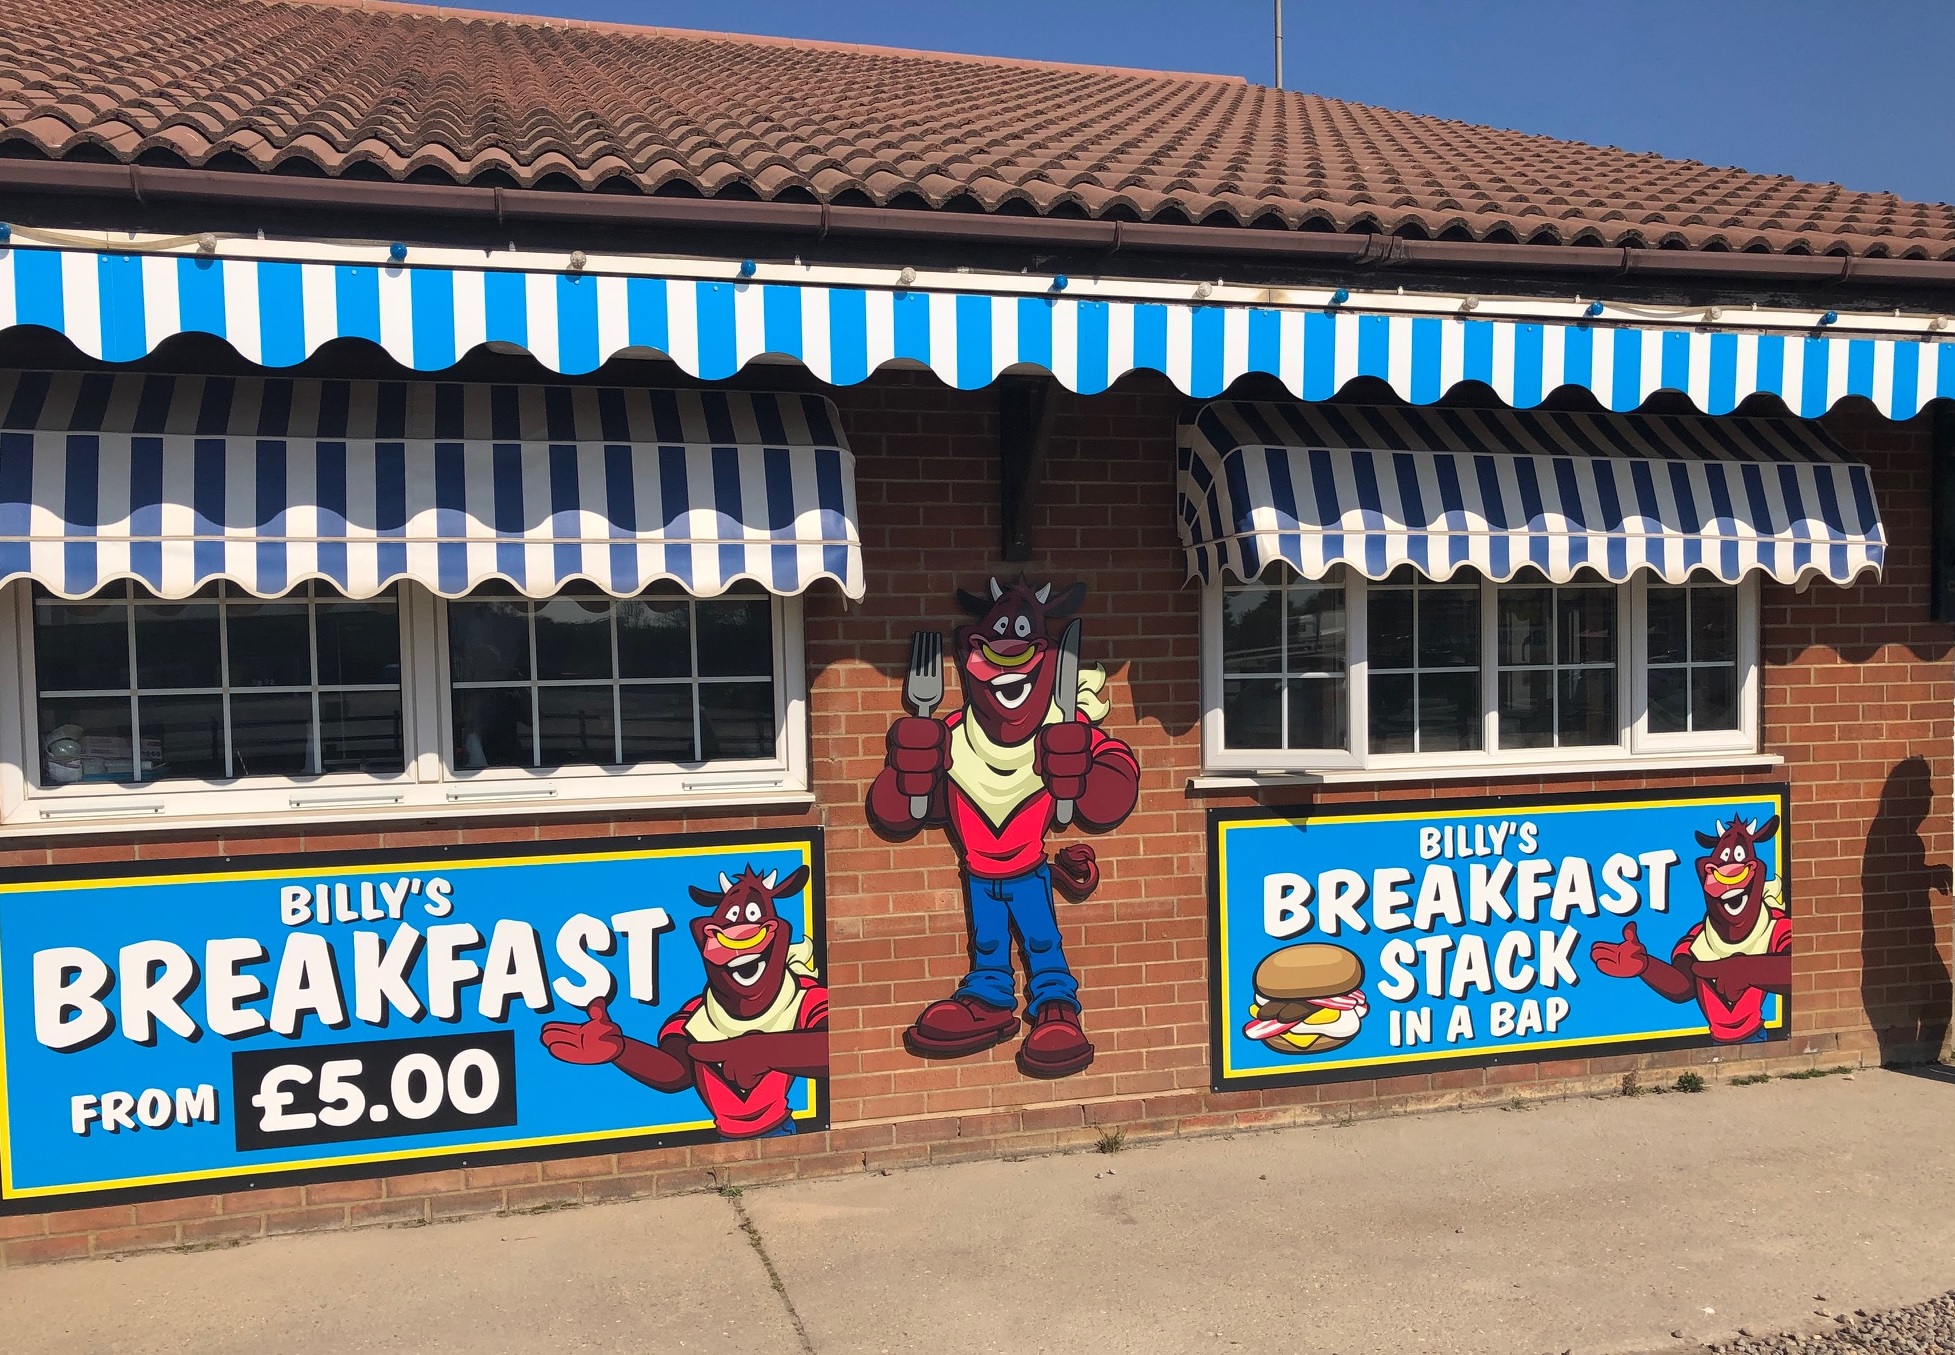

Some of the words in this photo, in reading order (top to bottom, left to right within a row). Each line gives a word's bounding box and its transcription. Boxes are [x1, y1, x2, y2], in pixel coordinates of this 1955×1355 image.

[1420, 821, 1538, 860] BILLY'S
[281, 878, 453, 926] BILLY'S
[1264, 850, 1677, 938] BREAKFAST
[34, 908, 671, 1049] BREAKFAST
[1377, 925, 1579, 1001] STACK
[1389, 1007, 1431, 1047] IN
[1446, 1004, 1474, 1043] A
[1490, 998, 1569, 1037] BAP
[71, 1084, 215, 1133] FROM
[251, 1048, 500, 1132] £5.00
